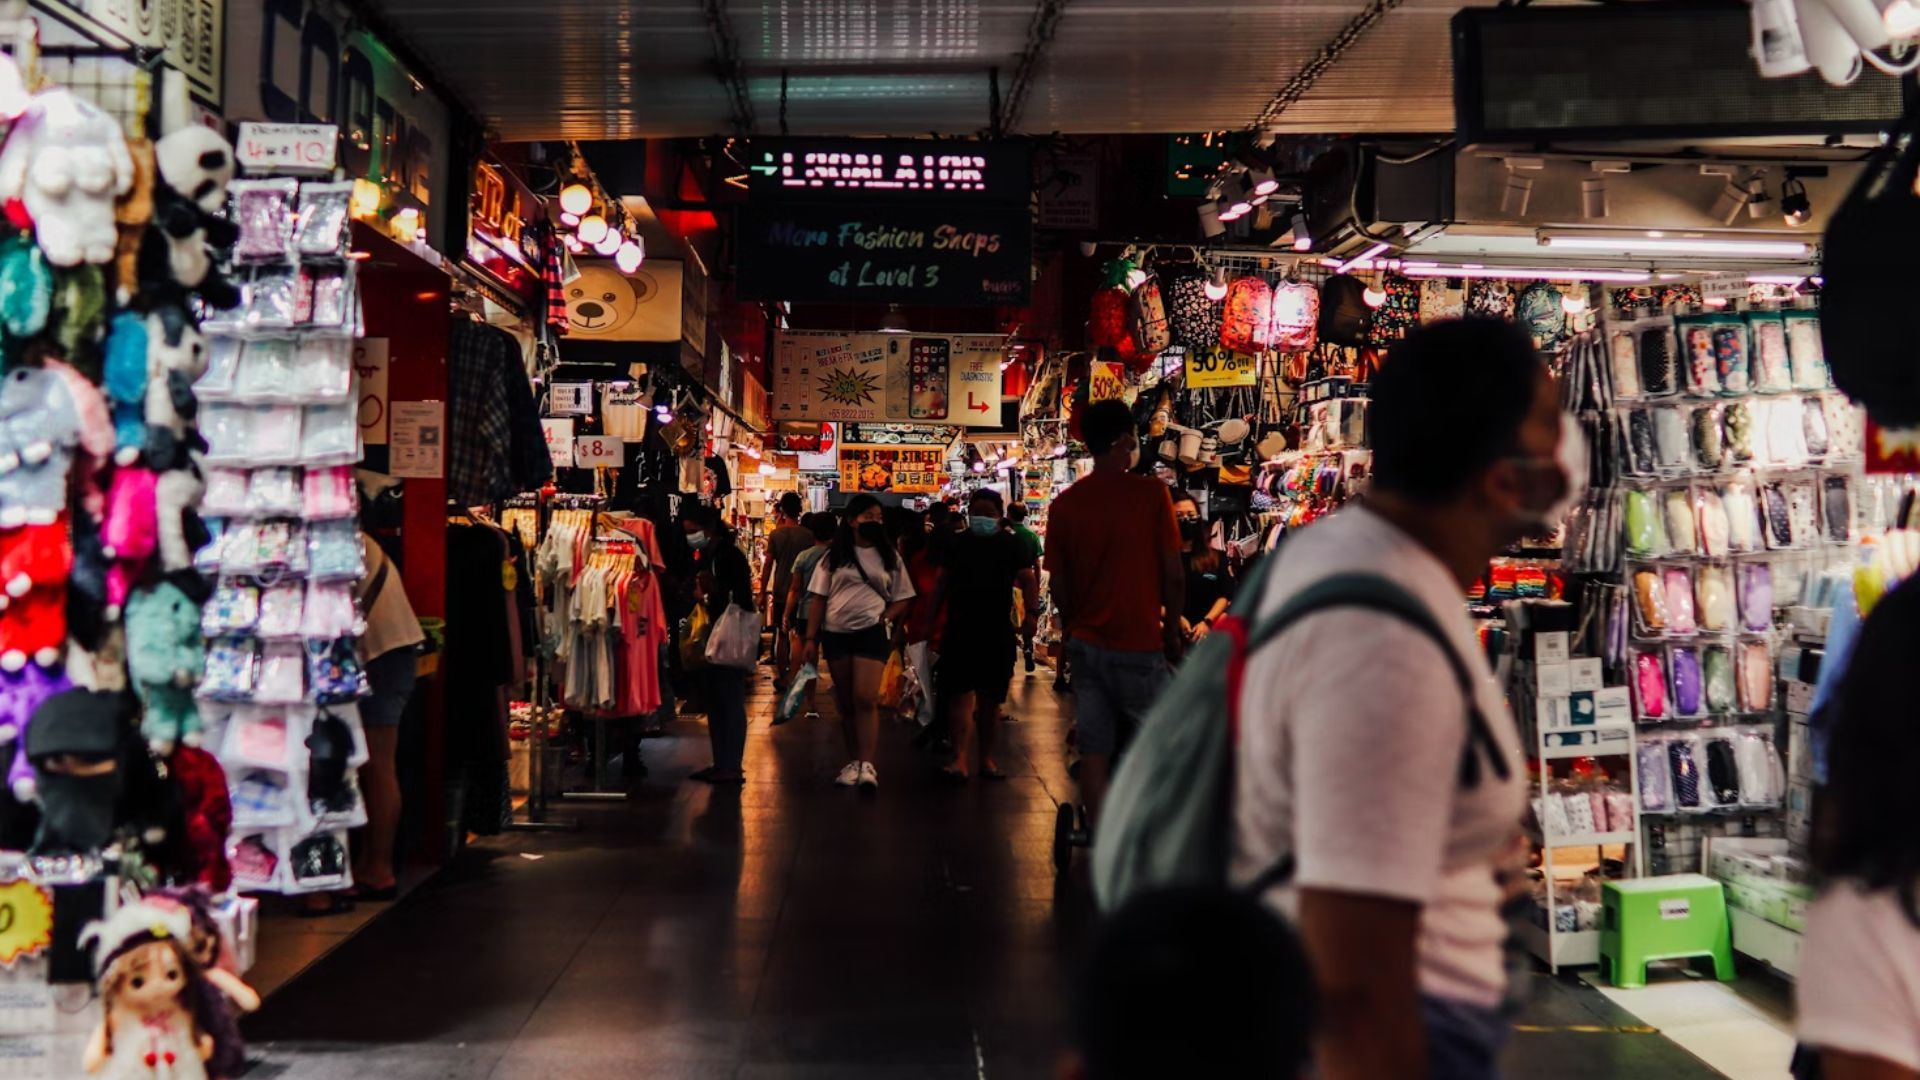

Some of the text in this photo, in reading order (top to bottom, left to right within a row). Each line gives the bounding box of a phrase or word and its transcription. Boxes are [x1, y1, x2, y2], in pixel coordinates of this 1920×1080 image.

[768, 220, 1001, 257] More Fashion Shops
[827, 260, 941, 288] at Level 3
[969, 361, 984, 371] FREE
[1191, 349, 1236, 373] 50%
[902, 450, 940, 463] STREET
